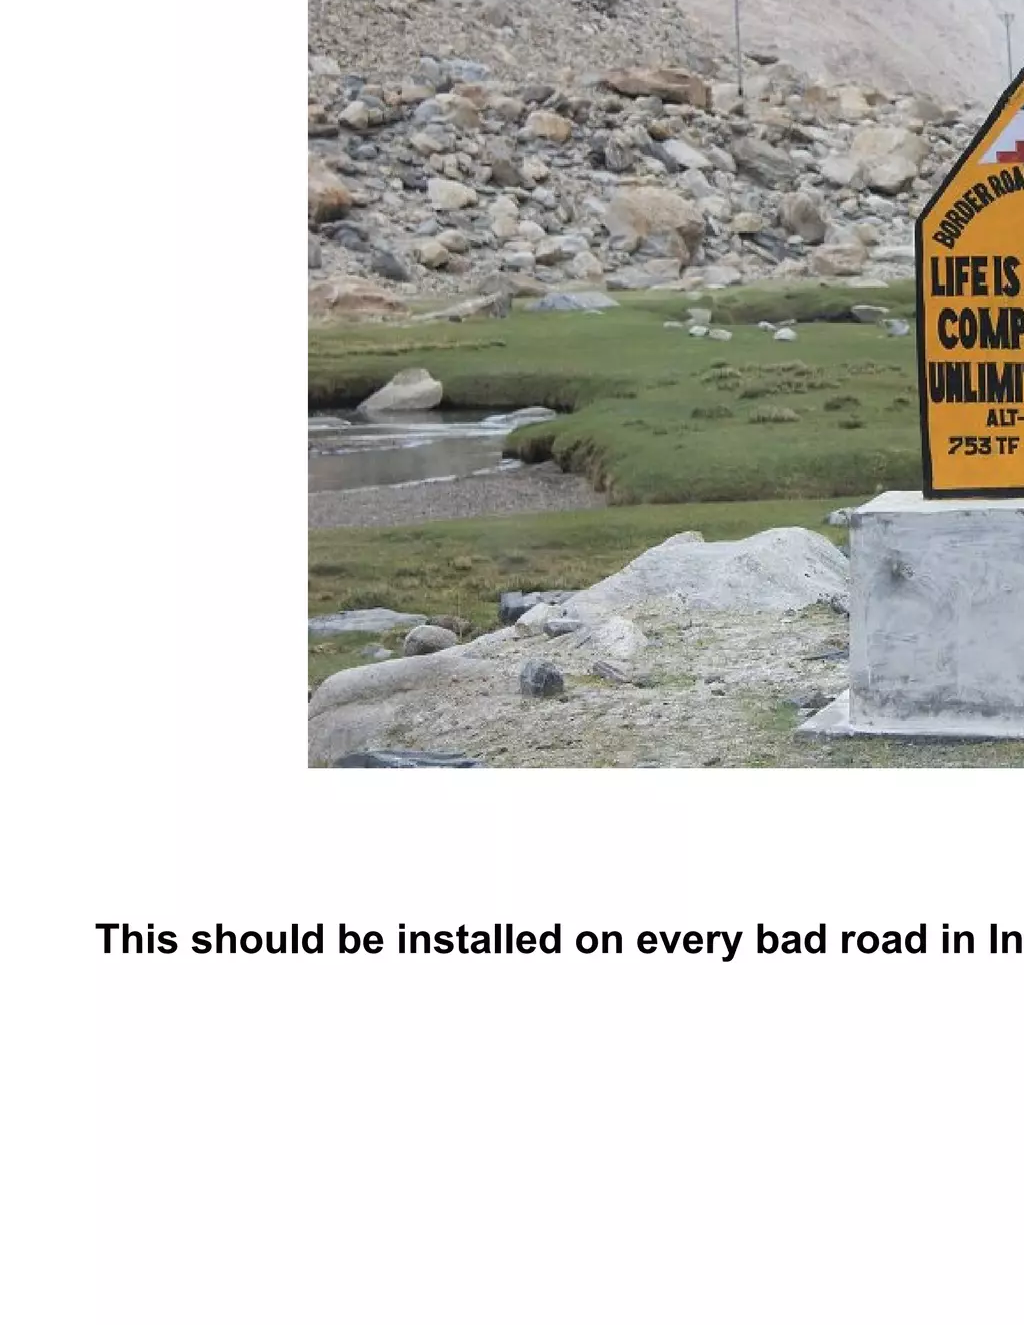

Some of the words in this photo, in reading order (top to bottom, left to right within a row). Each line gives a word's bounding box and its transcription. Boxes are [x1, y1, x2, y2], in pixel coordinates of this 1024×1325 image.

[932, 182, 992, 249] BORDER
[930, 255, 988, 297] LIFE
[992, 255, 1022, 297] IS
[948, 435, 992, 455] 753
[995, 436, 1020, 455] TF
[95, 923, 178, 955] This
[191, 923, 324, 955] should
[338, 923, 384, 955] be
[398, 923, 561, 955] installed
[575, 930, 623, 955] on
[636, 930, 744, 963] every
[757, 923, 827, 955] bad
[841, 923, 927, 955] road
[942, 923, 975, 955] in
